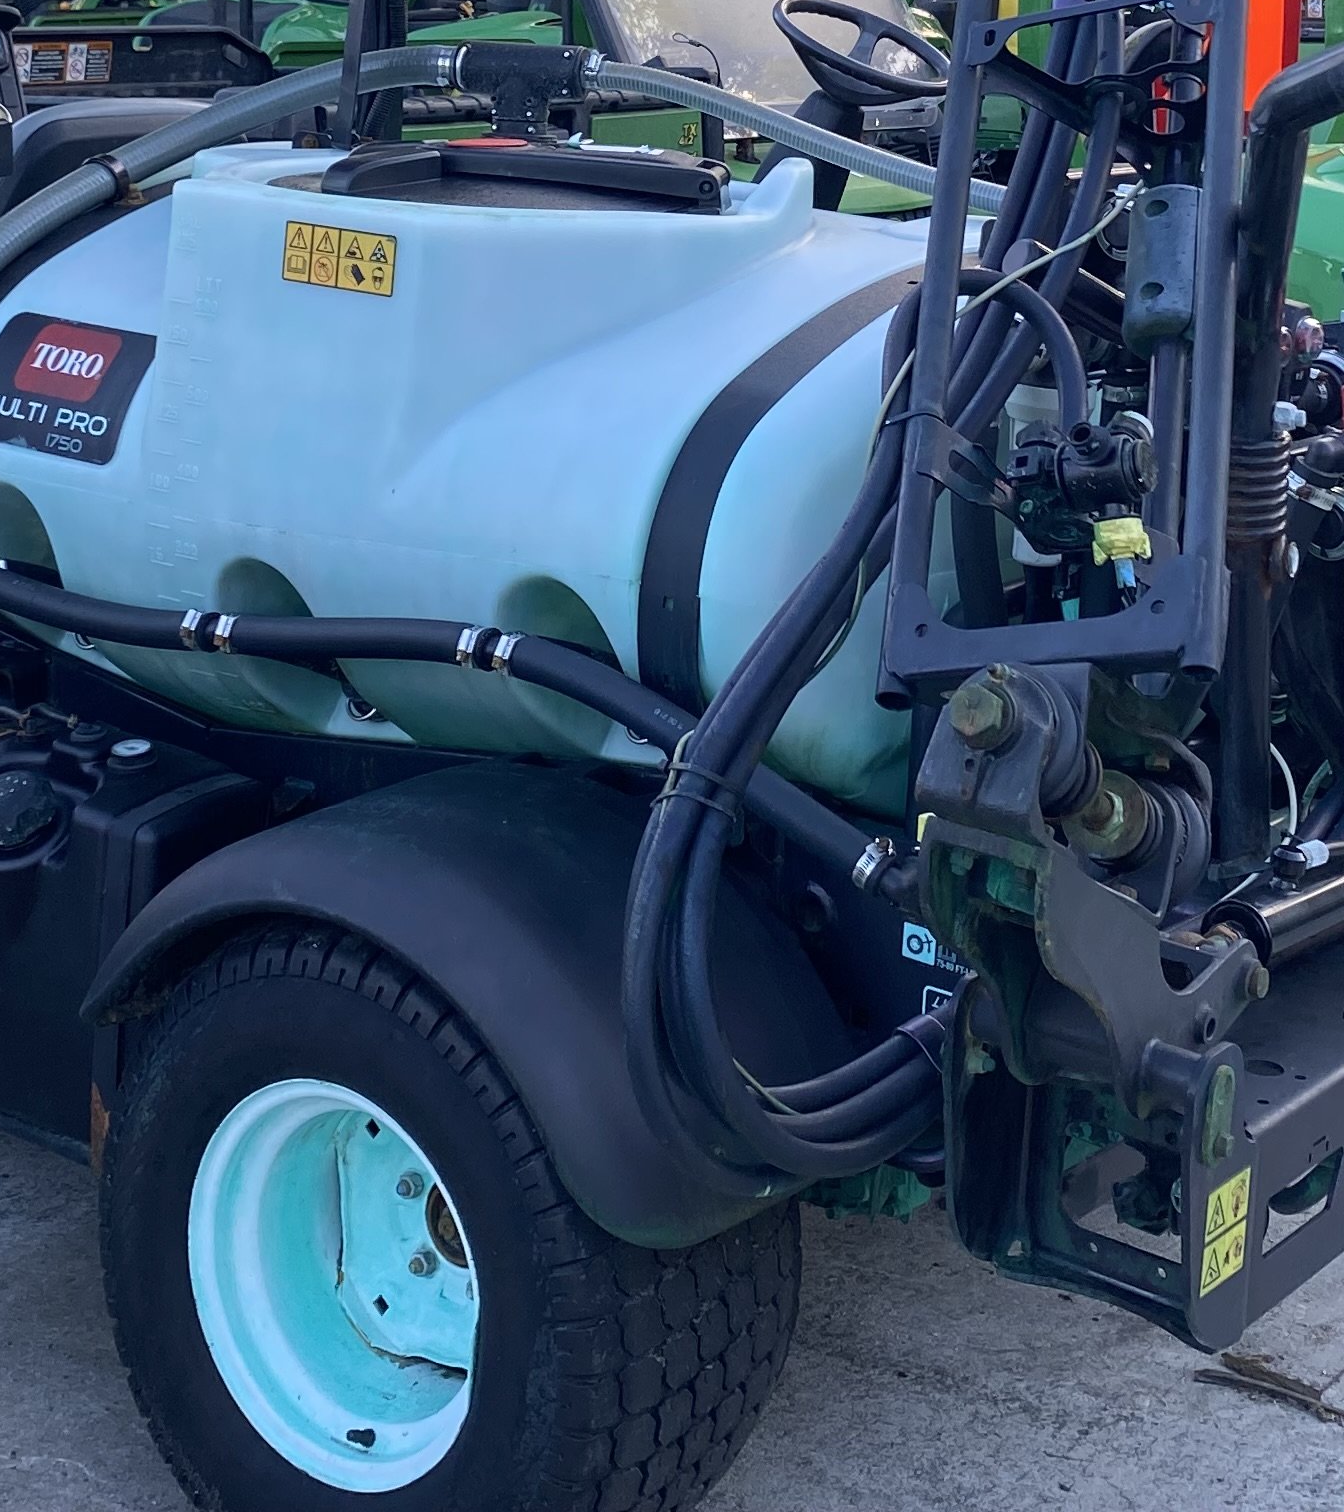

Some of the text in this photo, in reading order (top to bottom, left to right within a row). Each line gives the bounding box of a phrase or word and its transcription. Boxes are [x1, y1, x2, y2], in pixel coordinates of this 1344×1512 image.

[683, 123, 697, 136] TX
[30, 342, 104, 380] TORO
[53, 408, 110, 436] PRO
[45, 432, 83, 453] 1750
